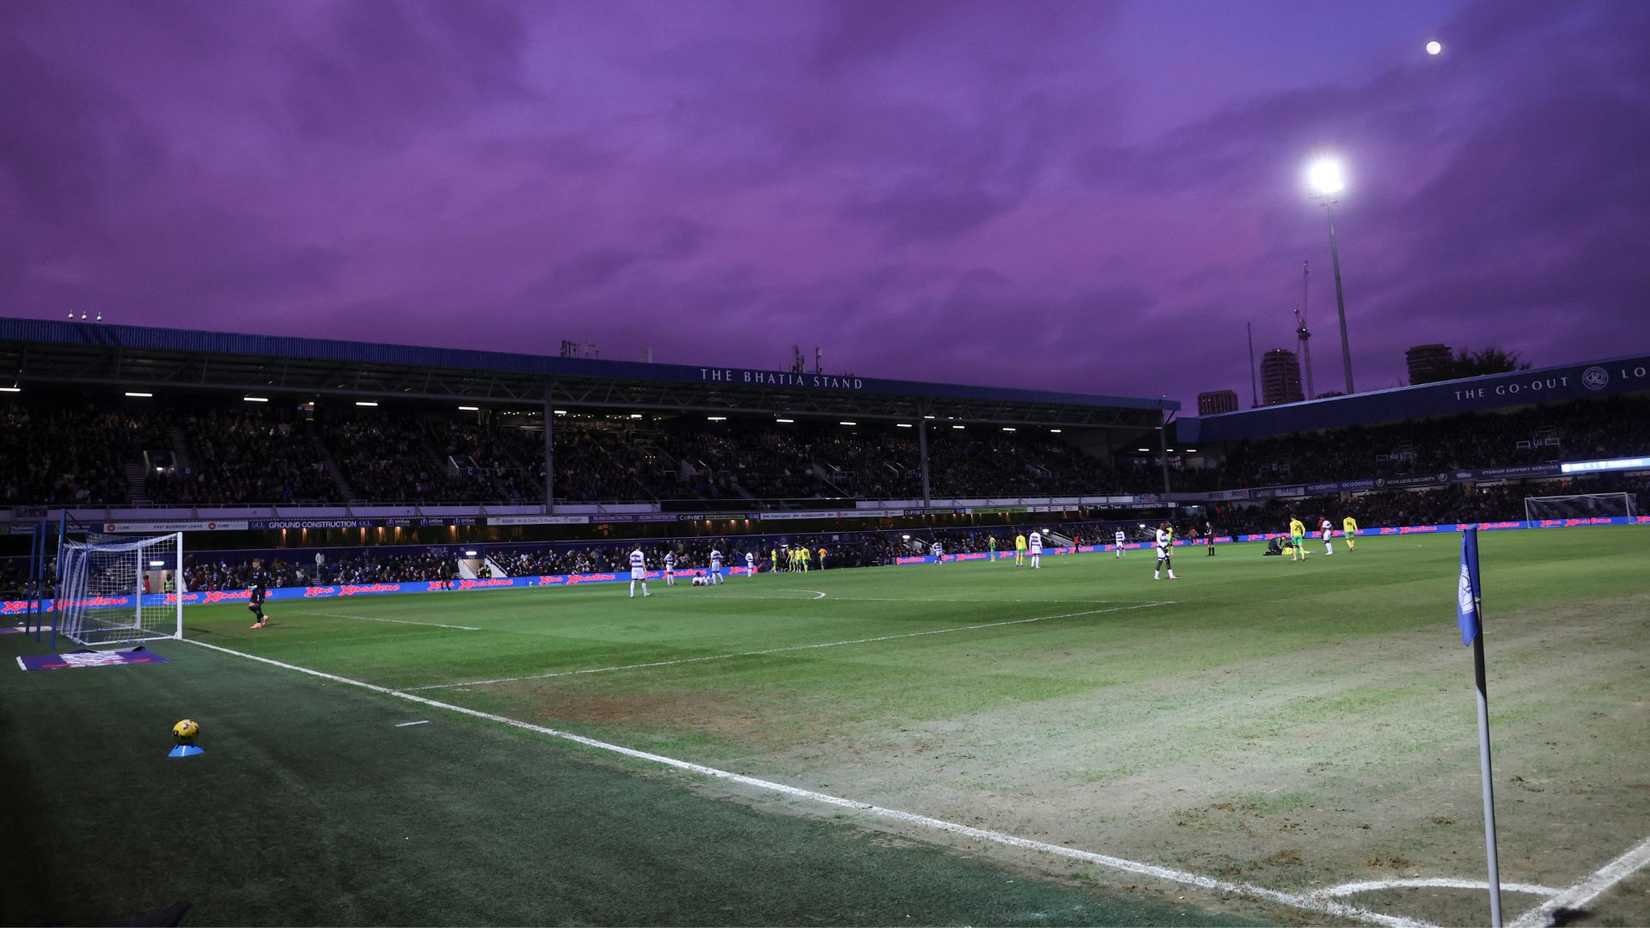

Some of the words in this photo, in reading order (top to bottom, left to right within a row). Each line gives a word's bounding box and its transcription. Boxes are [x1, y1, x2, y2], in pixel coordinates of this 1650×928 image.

[700, 368, 733, 382] THE
[744, 371, 804, 386] BHATIA
[814, 377, 864, 390] STAND
[1455, 388, 1486, 401] THE
[268, 521, 301, 529] GROUND
[301, 520, 357, 529] CONSTRUCTION
